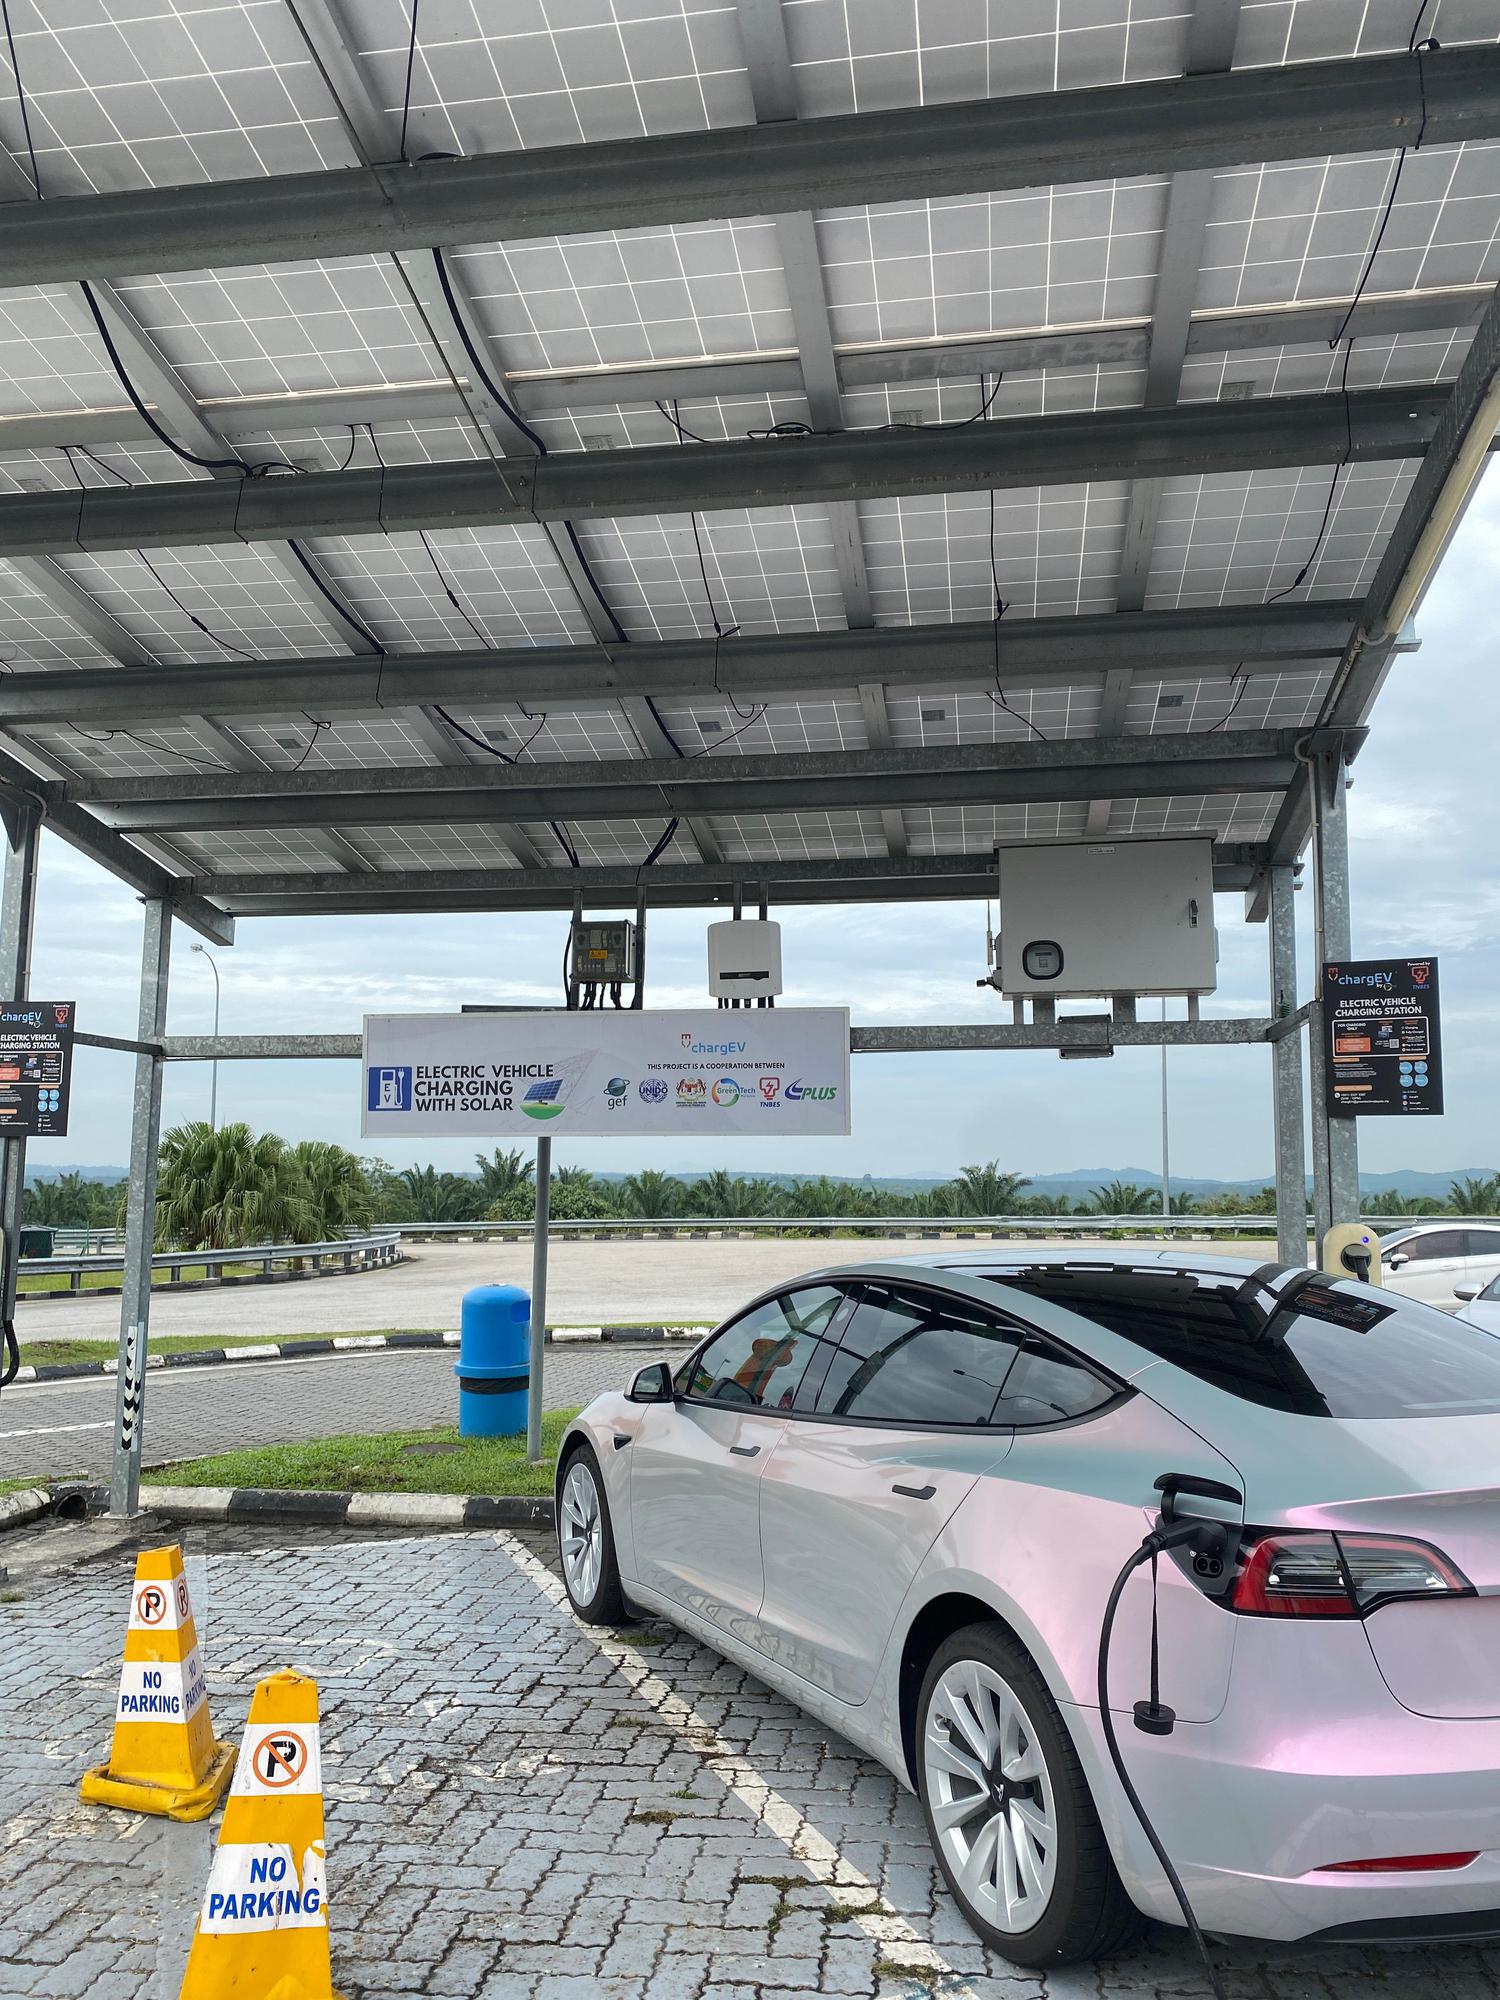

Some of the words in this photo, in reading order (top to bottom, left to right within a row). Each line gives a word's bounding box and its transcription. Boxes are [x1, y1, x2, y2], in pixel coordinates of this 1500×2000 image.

[1339, 972, 1392, 986] chargEV
[1340, 999, 1379, 1008] ELECTRIC
[1380, 997, 1416, 1006] VEHICLE
[2, 1012, 42, 1023] chargEV
[1335, 1008, 1382, 1017] CHARGING
[1385, 1006, 1422, 1015] STATION
[691, 1042, 746, 1055] chargEV
[416, 1066, 485, 1079] ELECTRIC
[492, 1065, 554, 1077] VEHICLE
[414, 1081, 513, 1096] CHARGING
[801, 1087, 837, 1100] PLUS
[416, 1099, 456, 1111] WITH
[460, 1098, 513, 1111] SOLAR
[608, 1095, 627, 1110] gef
[188, 1660, 197, 1679] NO
[143, 1671, 162, 1689] NO
[185, 1675, 206, 1710] PARKING
[121, 1695, 180, 1714] PARKING
[250, 1856, 286, 1883] NO
[209, 1888, 320, 1919] PARKING
